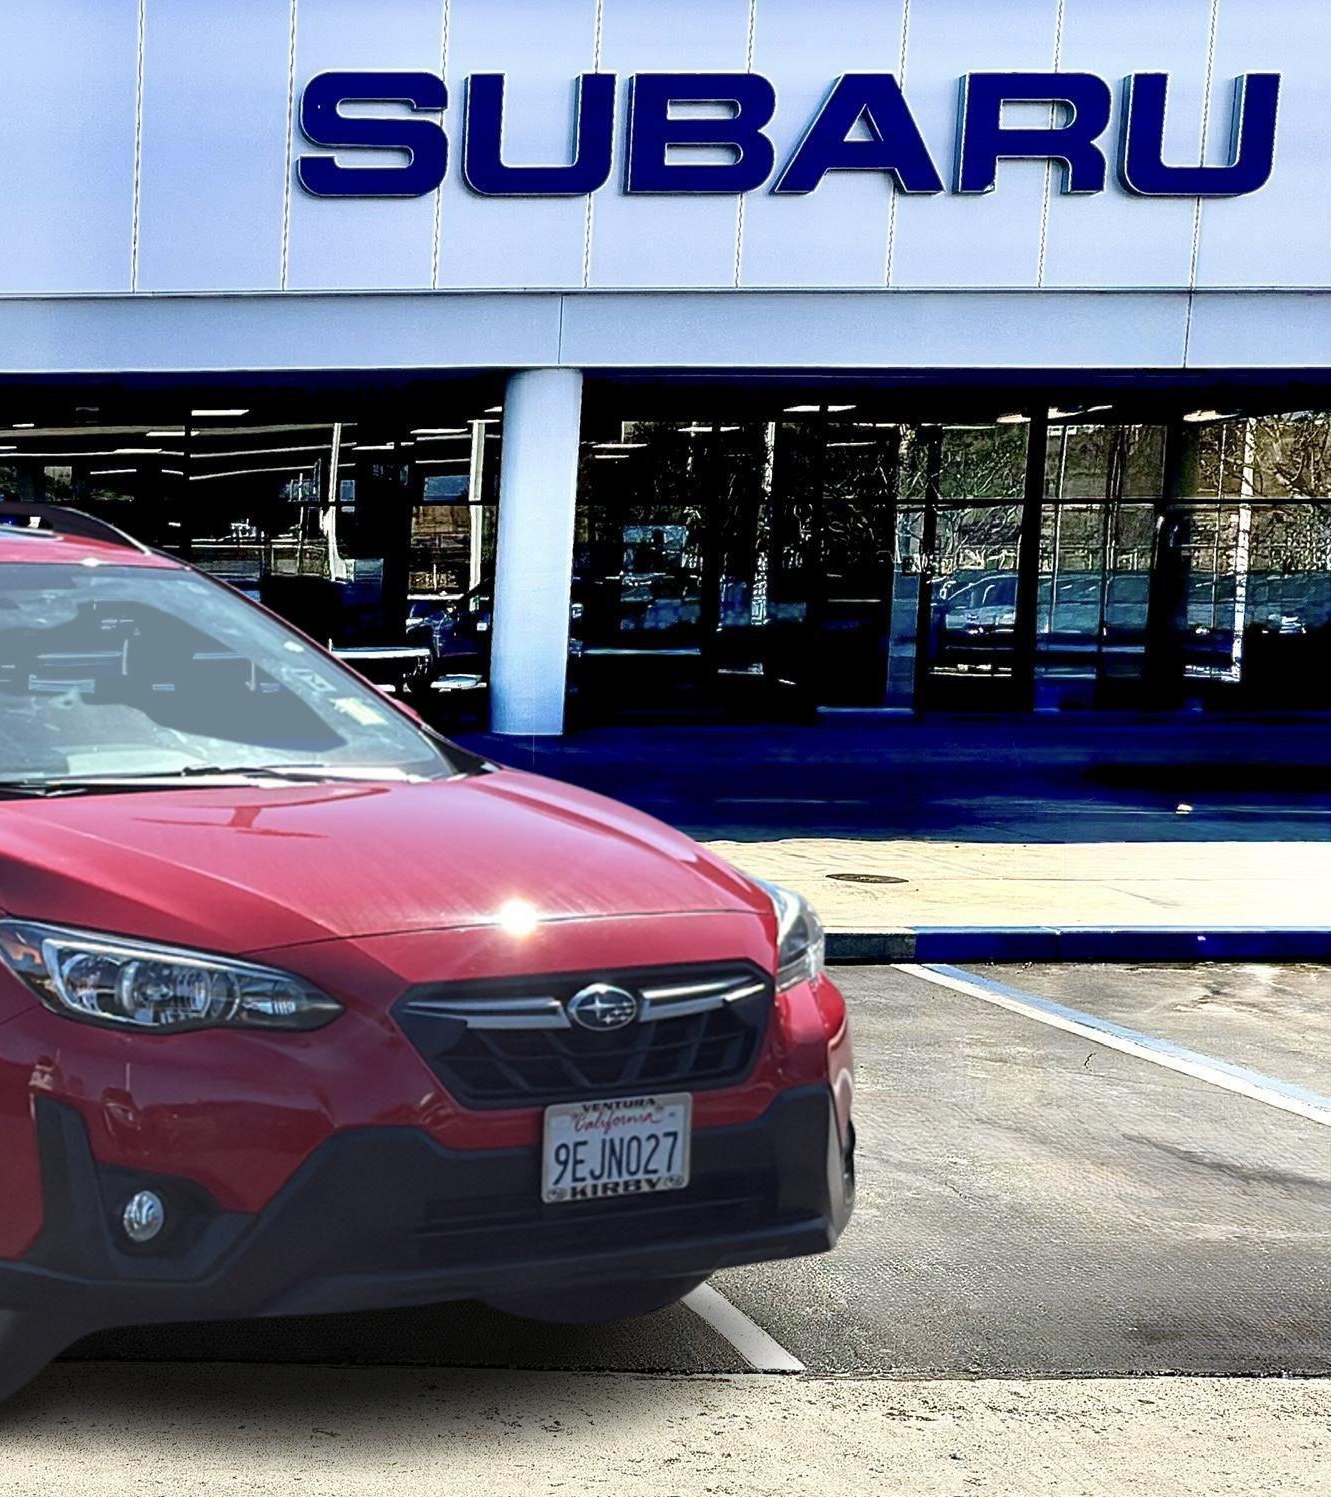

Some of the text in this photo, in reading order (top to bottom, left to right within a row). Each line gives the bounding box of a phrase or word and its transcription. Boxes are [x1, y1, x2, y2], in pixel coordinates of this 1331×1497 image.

[297, 71, 1281, 197] SUBARU
[582, 1098, 655, 1113] VENTURA
[574, 1112, 663, 1136] California
[552, 1131, 679, 1187] 9EJN027
[571, 1176, 663, 1199] KIRBY
